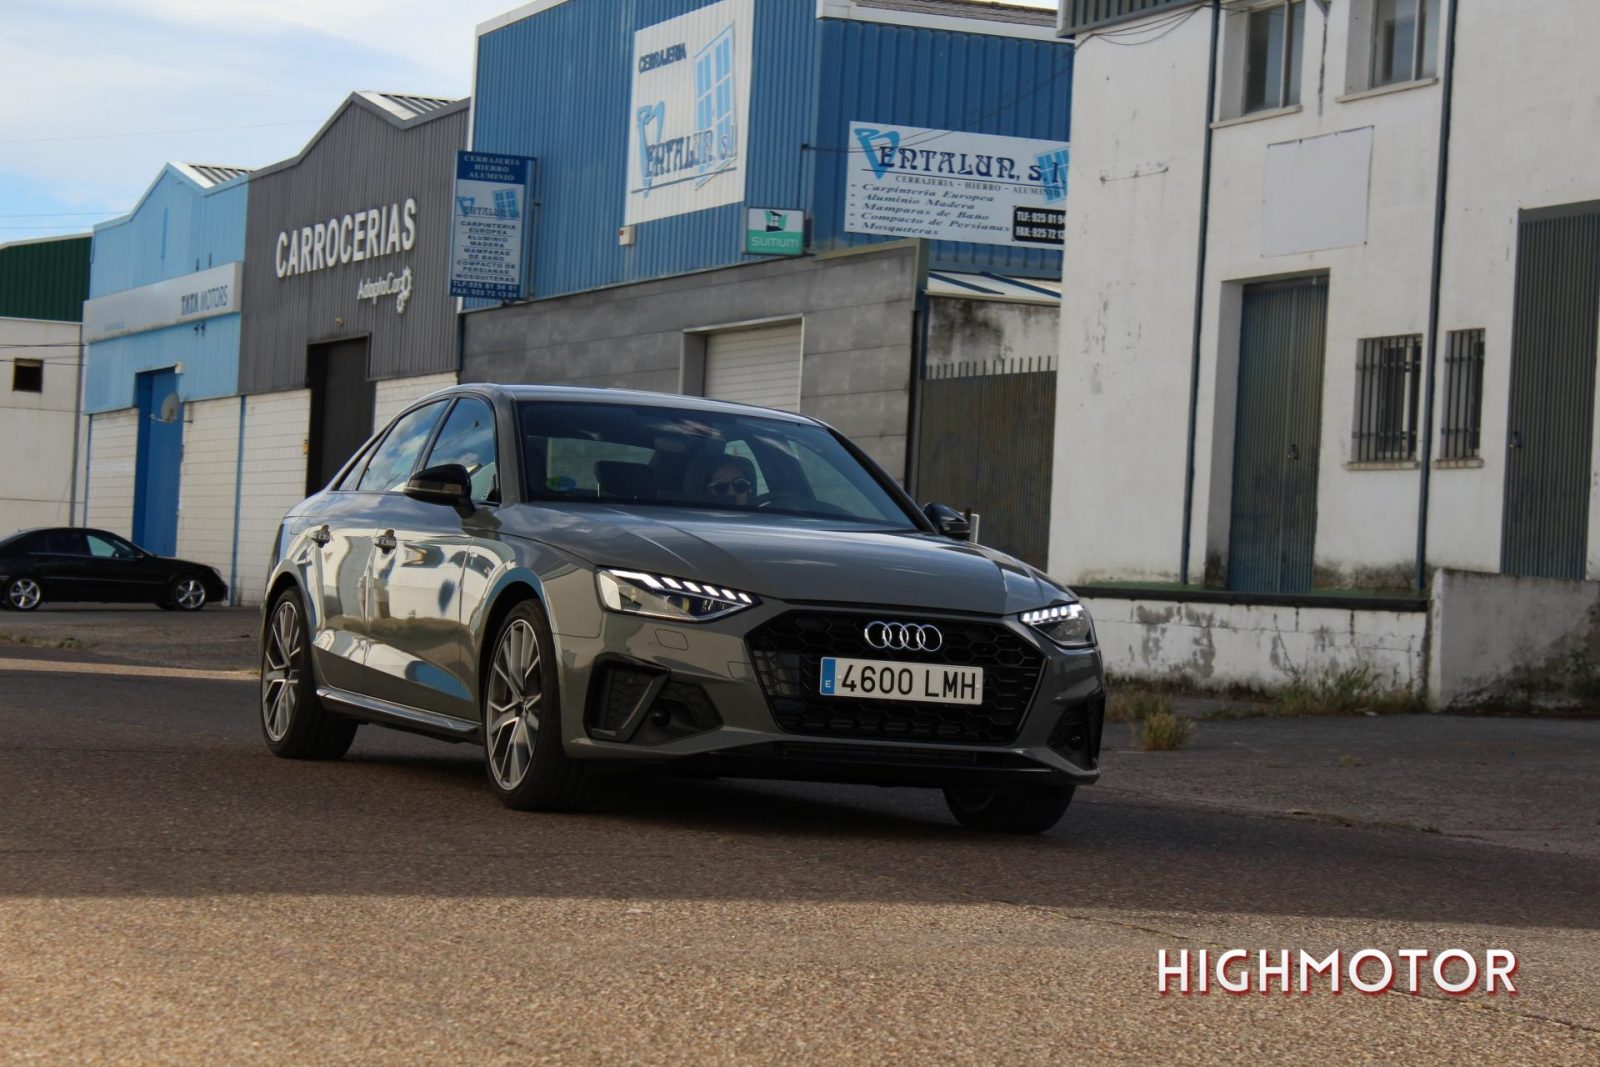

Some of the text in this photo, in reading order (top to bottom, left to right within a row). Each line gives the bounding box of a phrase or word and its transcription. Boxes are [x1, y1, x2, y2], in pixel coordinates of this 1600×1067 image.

[638, 42, 687, 74] CERRAJERIA
[464, 155, 520, 165] CERRAJERIA
[474, 164, 509, 173] HIERRO
[469, 171, 514, 181] ALUMINIO
[895, 175, 954, 188] CERRAJERIA
[965, 181, 1001, 192] HIERRO
[863, 194, 975, 210] Aluminio Madera
[943, 191, 994, 202] Europea
[862, 202, 931, 215] Mamparas
[460, 220, 516, 230] CARPINTERIA
[860, 212, 924, 224] Compacto
[949, 220, 1010, 232] Persianas
[468, 227, 507, 235] EUROPEA
[861, 222, 939, 235] Mosquiteras
[276, 198, 417, 278] CARROCERIAS
[466, 234, 508, 243] ALUMINIO
[751, 236, 799, 249] sumum
[463, 247, 510, 256] MAMPARAS
[456, 260, 503, 269] COMPACTO
[462, 266, 510, 275] PERSIANAS
[455, 273, 516, 283] MOSQUITERAS
[181, 284, 229, 316] TATA MOTORS
[824, 664, 976, 700] E 4600 LMH
